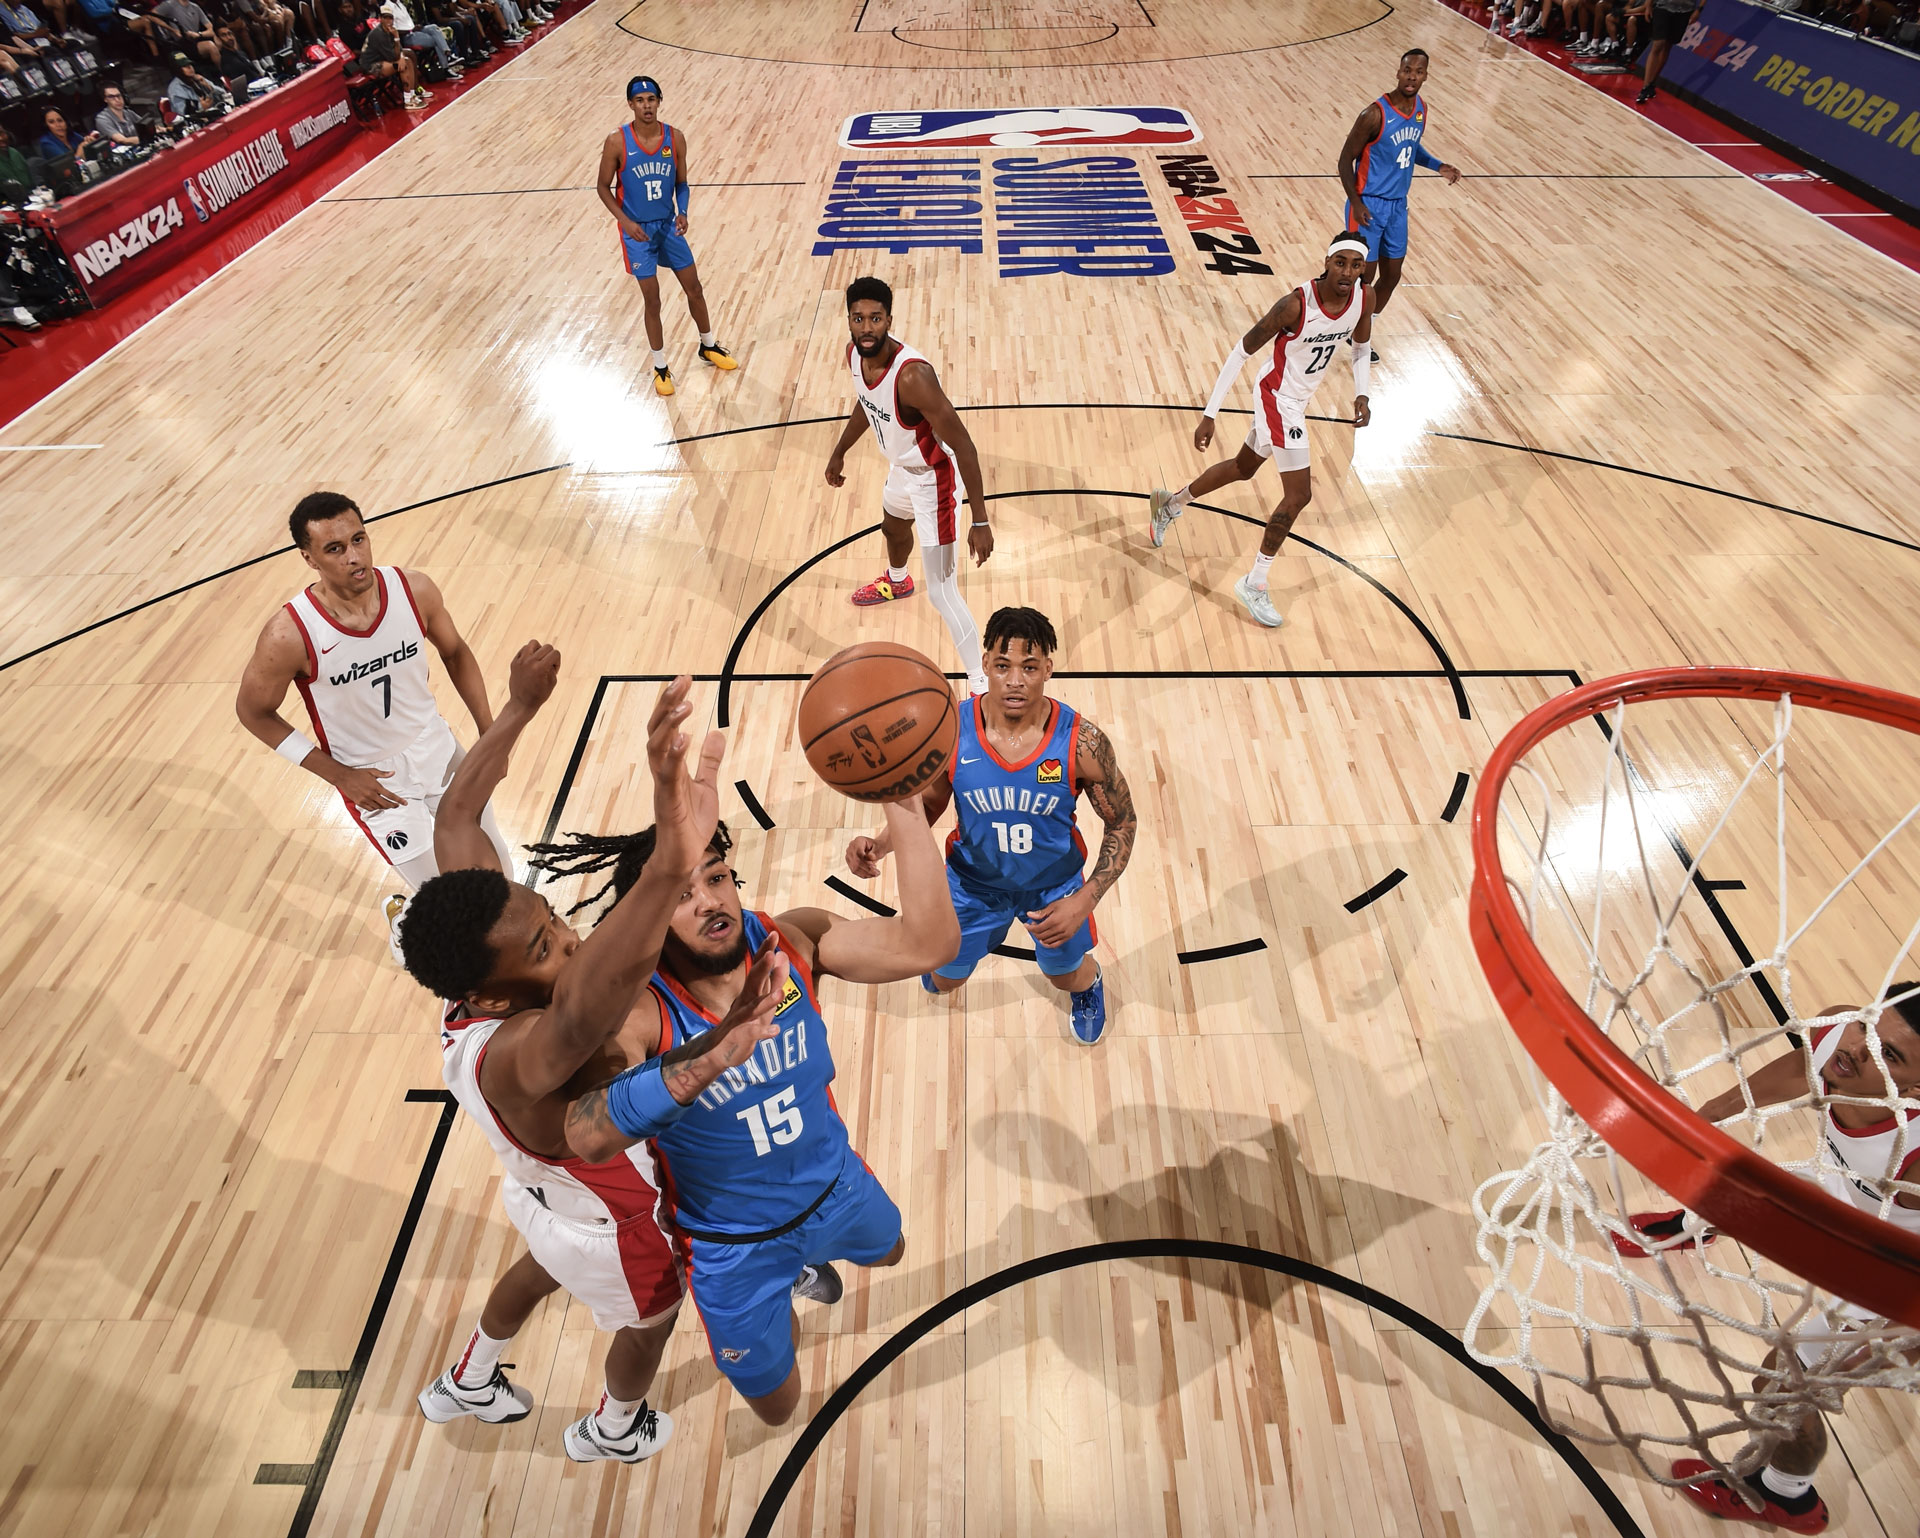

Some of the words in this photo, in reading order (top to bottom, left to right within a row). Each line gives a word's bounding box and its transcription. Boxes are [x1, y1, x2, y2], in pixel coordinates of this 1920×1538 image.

[1676, 21, 1760, 72] BA2K24
[1753, 54, 1901, 137] PRE-ORDER
[867, 115, 923, 135] NBA
[197, 149, 256, 213] SUMMER
[244, 127, 289, 185] LEAGUE
[631, 162, 672, 179] THUNDER
[1395, 145, 1413, 170] 42
[644, 180, 663, 202] 13
[810, 158, 983, 256] LEAGUE
[992, 155, 1178, 278] SUMMER
[1155, 154, 1275, 277] NBA2K24
[73, 197, 184, 285] NBA2K24
[1303, 326, 1353, 343] wizard
[1304, 344, 1336, 375] 23
[870, 414, 887, 450] 11
[329, 640, 418, 686] wizards
[371, 674, 392, 719] 7
[1039, 773, 1061, 782] Love's
[962, 785, 1060, 816] THUNDER
[991, 821, 1033, 855] 18
[775, 987, 800, 1011] ove's
[735, 1083, 804, 1157] 15
